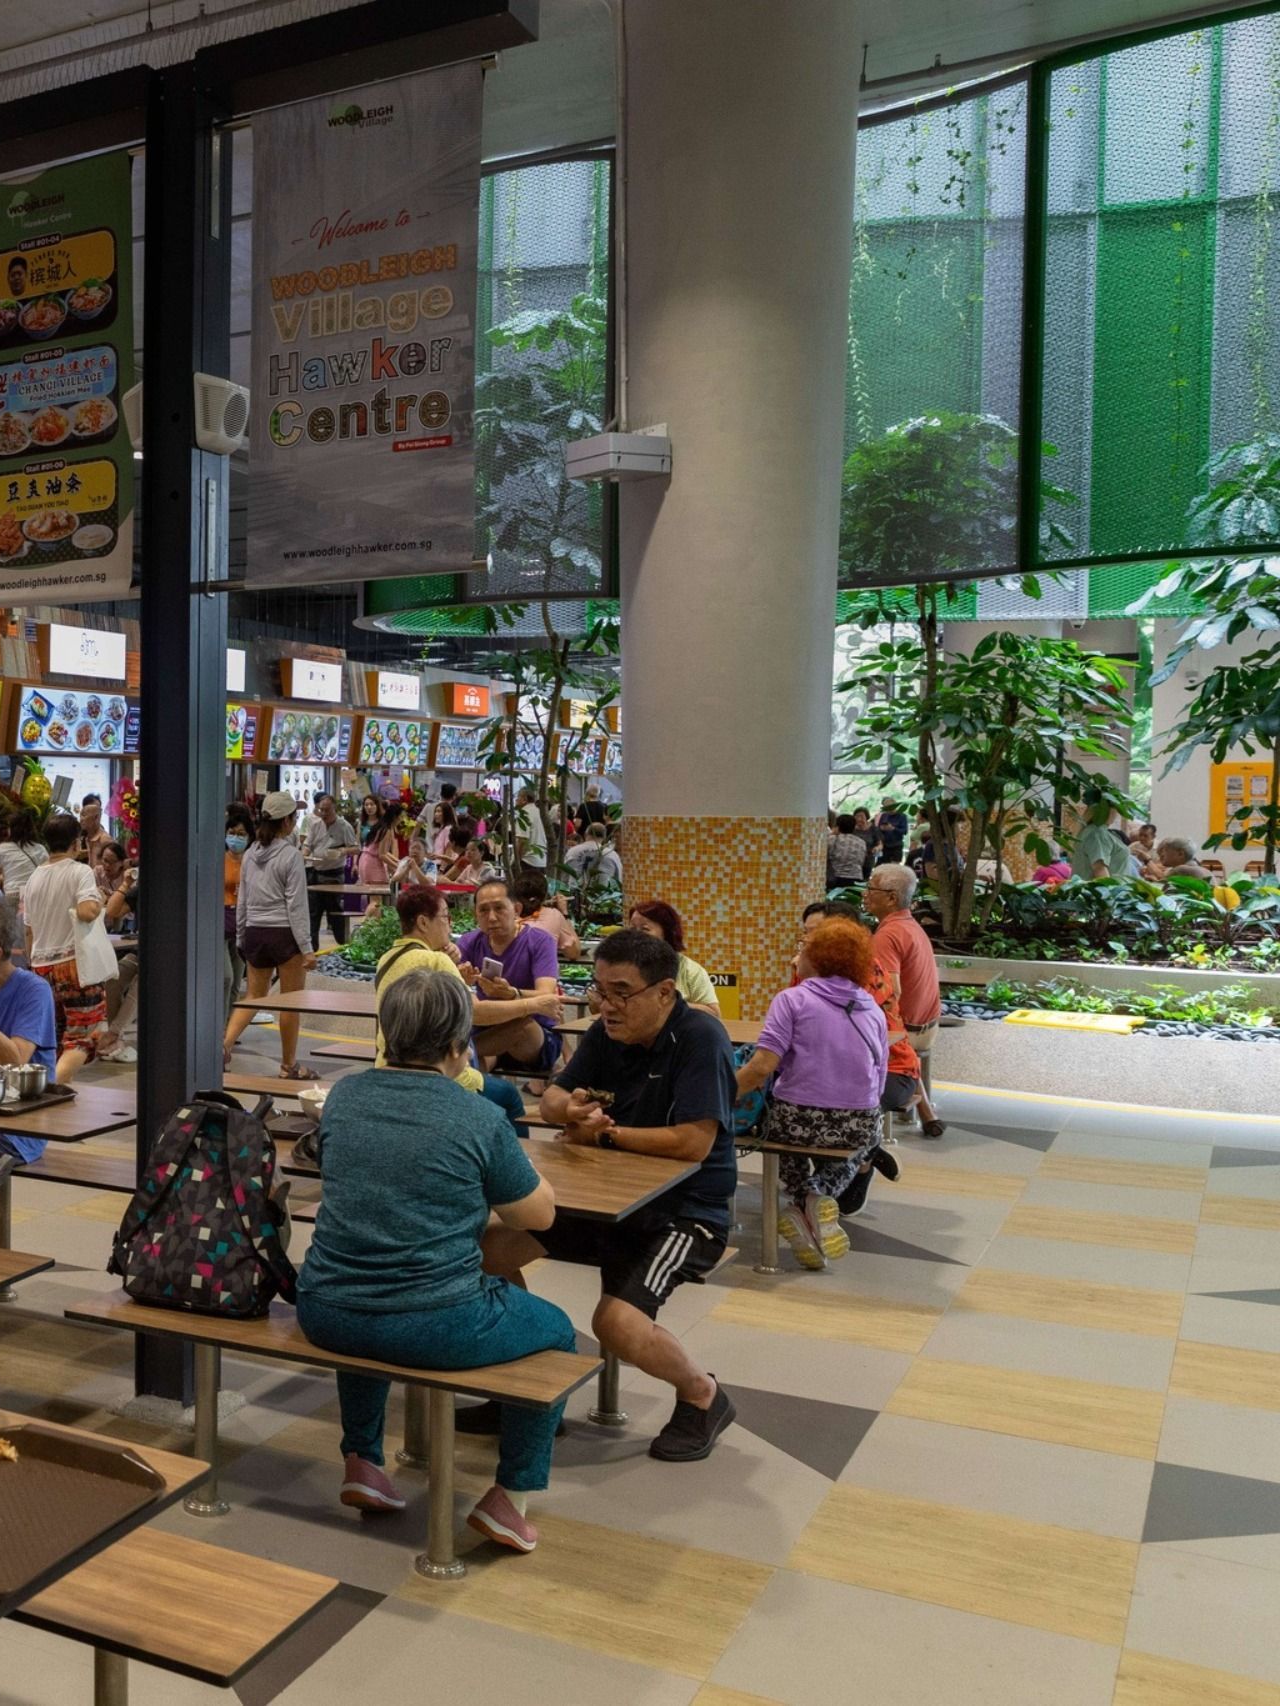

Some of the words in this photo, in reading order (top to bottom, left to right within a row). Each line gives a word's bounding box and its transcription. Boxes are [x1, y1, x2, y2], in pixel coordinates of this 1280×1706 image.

[328, 105, 393, 127] WOODLEIGH
[359, 116, 393, 129] Village
[8, 193, 64, 215] WOODLEIGH
[310, 209, 388, 249] Welcome
[395, 209, 410, 227] to
[20, 241, 35, 251] Stall
[270, 243, 457, 300] WOODLEIGH
[270, 285, 454, 343] Village
[268, 336, 452, 397] Hawker
[18, 380, 56, 396] CHANGI
[59, 372, 102, 388] VILLAGE
[269, 385, 451, 448] Centre
[283, 540, 433, 560] www.woodleighhawker.com.sg
